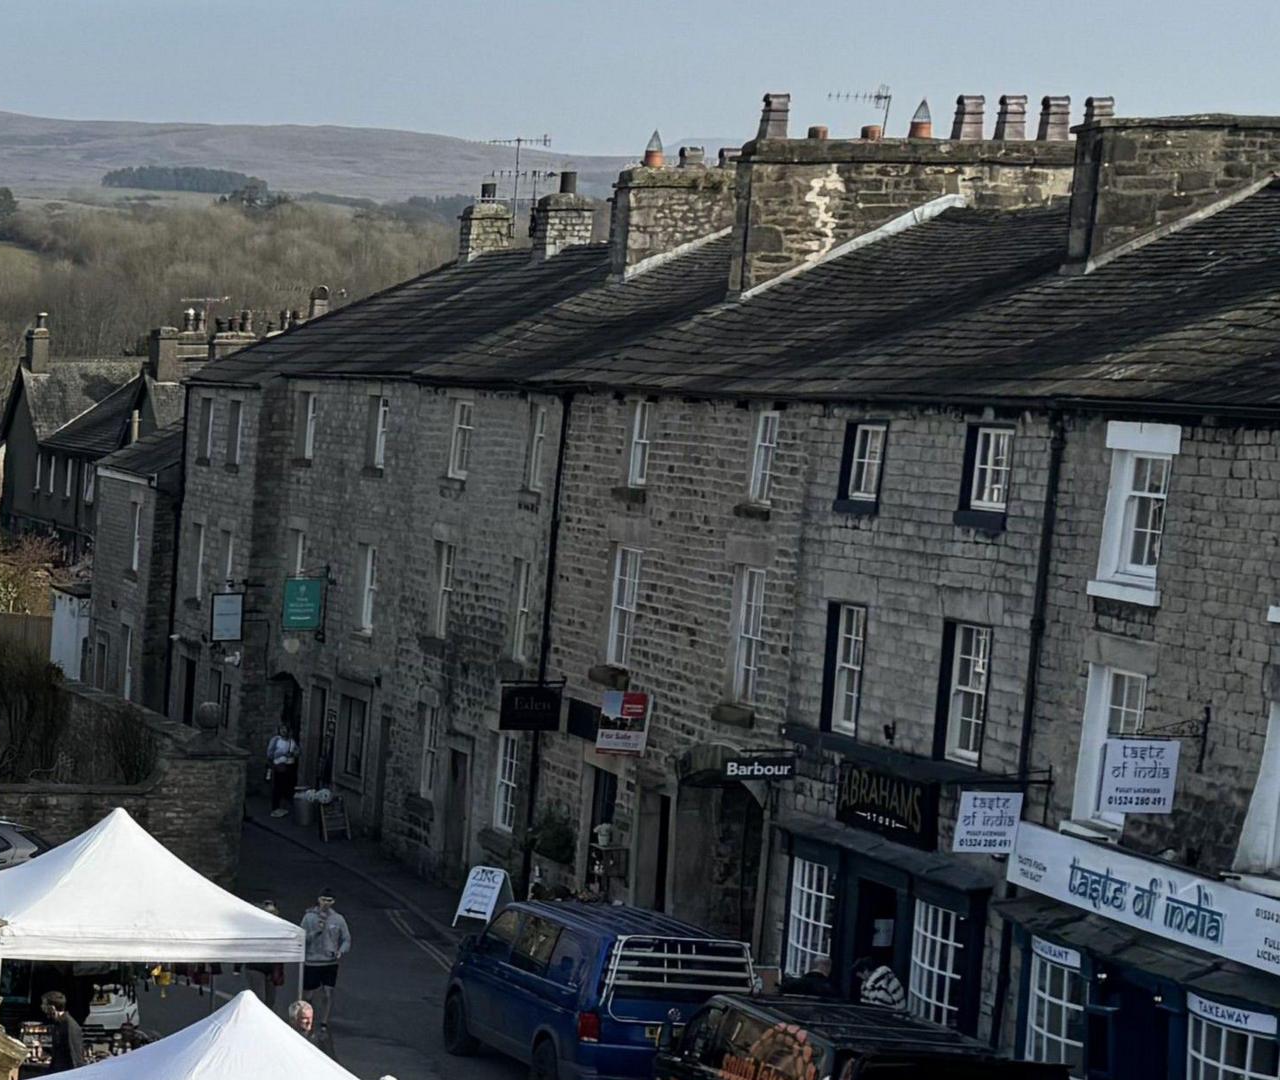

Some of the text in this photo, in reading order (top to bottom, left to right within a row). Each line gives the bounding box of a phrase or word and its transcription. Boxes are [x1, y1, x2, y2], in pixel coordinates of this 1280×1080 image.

[726, 761, 792, 776] Barbour
[839, 767, 922, 834] ABRAHAMS
[1068, 857, 1226, 946] taste of india
[1200, 1001, 1250, 1025] TAKEAWAY
